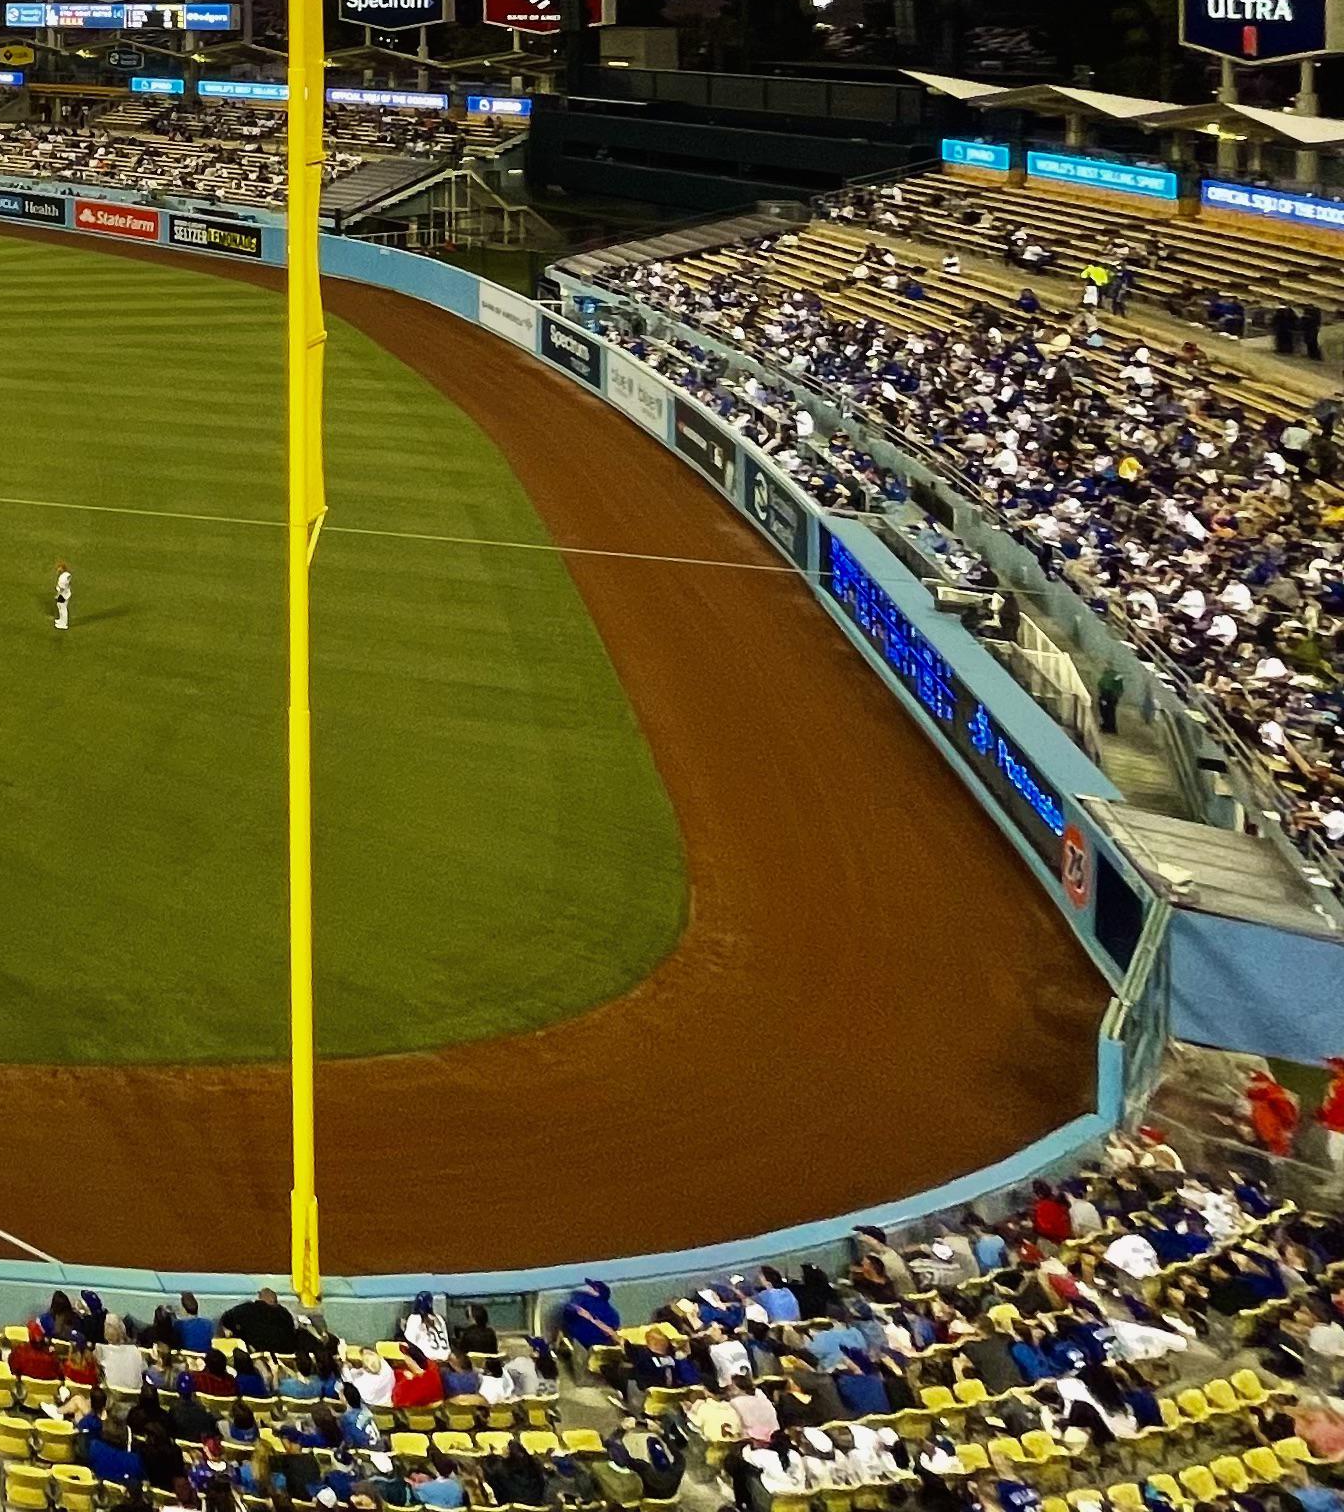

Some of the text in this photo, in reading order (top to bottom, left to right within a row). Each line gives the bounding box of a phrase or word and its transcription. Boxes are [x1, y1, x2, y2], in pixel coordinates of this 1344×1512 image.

[24, 199, 59, 217] Health
[174, 225, 207, 245] SELTZER
[550, 324, 590, 361] Spectrum
